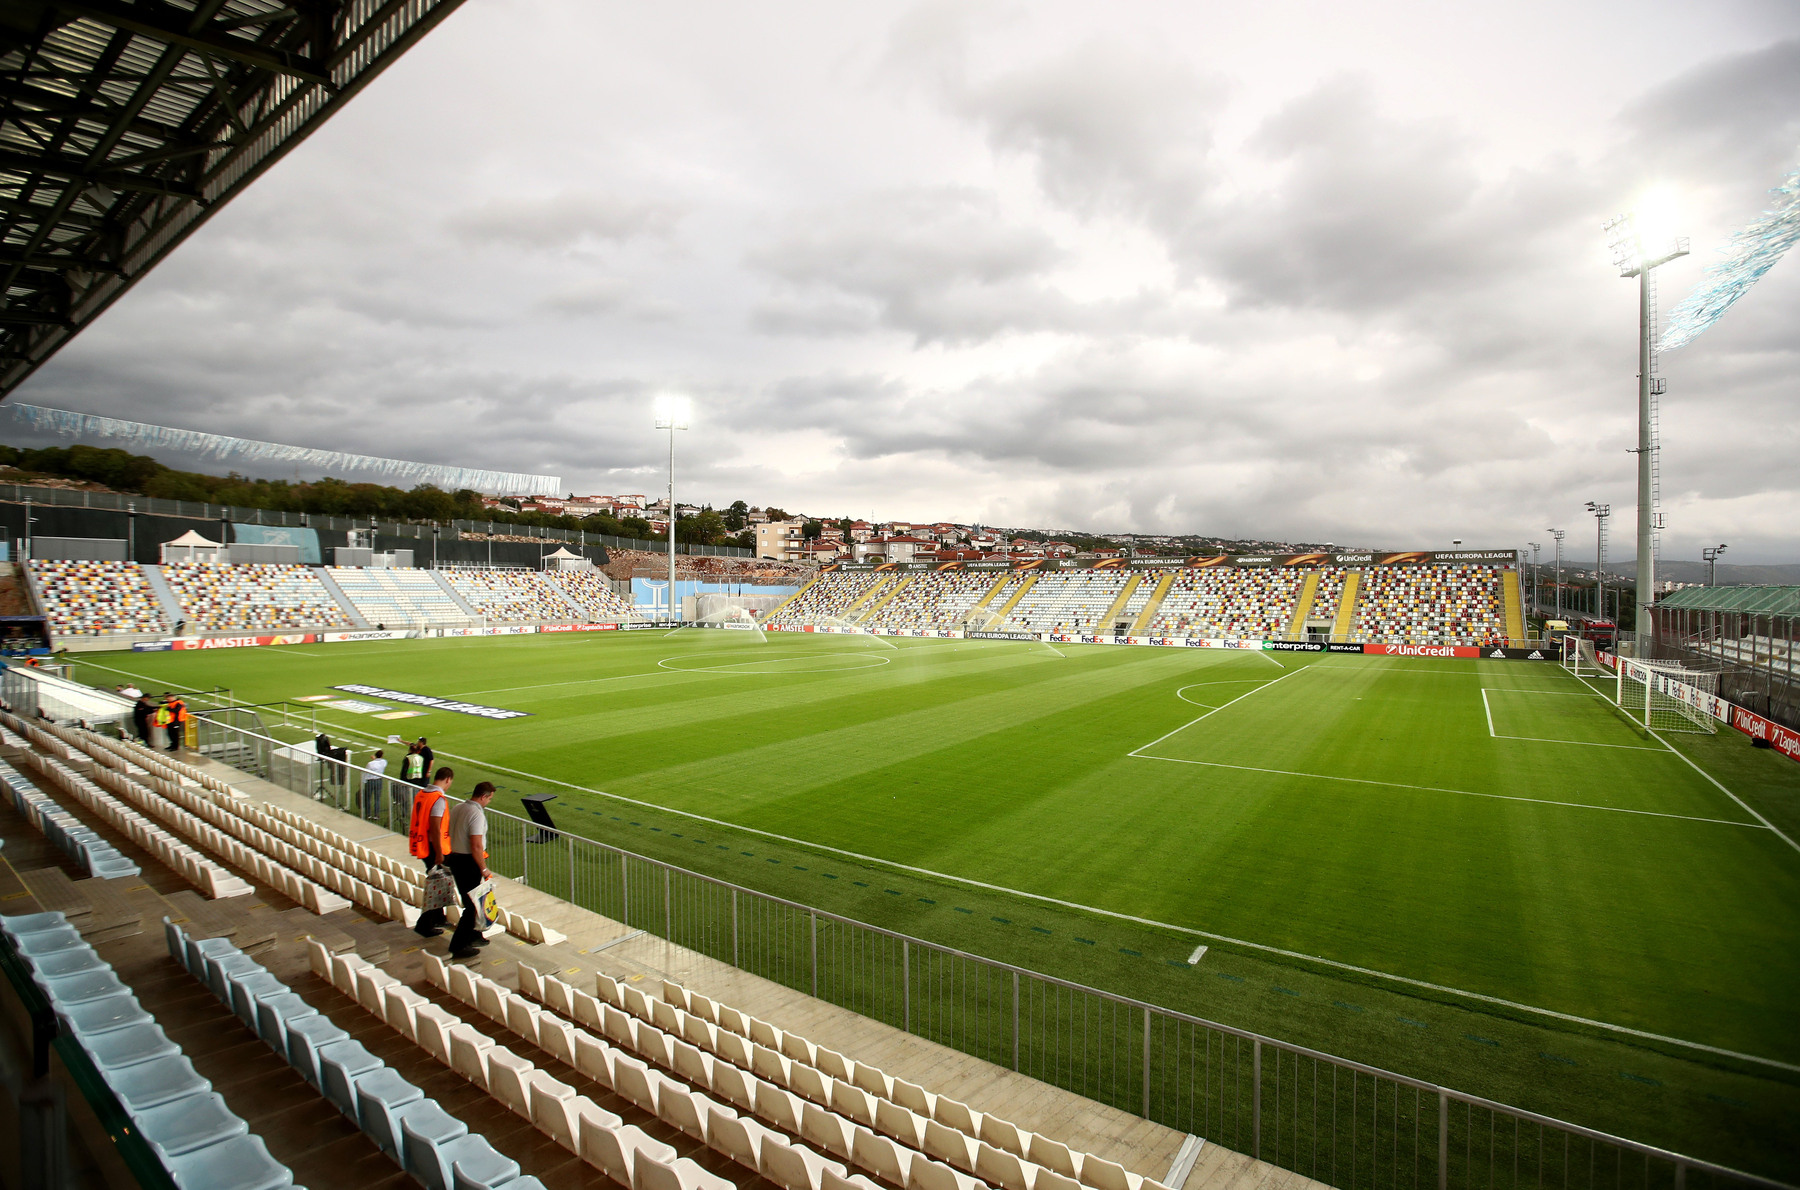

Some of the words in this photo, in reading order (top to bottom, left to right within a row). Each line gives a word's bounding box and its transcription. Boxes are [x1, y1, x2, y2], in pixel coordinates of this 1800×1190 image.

[1344, 554, 1372, 562] UniCredit
[938, 630, 956, 638] FedEx
[987, 632, 1009, 640] EUROPA
[202, 637, 260, 649] AMSTEL
[1050, 634, 1071, 642] FedEx
[1082, 635, 1104, 643] FedEx
[1115, 636, 1138, 644] FedEx
[1149, 637, 1174, 646] FedEx
[1186, 638, 1211, 647] FedEx
[1224, 640, 1250, 649] FedEx
[1263, 642, 1321, 651] enterprise
[1398, 645, 1455, 656] UniCredit
[431, 701, 528, 719] LEAGUE
[1740, 711, 1766, 739] UniCredit
[1779, 730, 1800, 756] Zagreb
